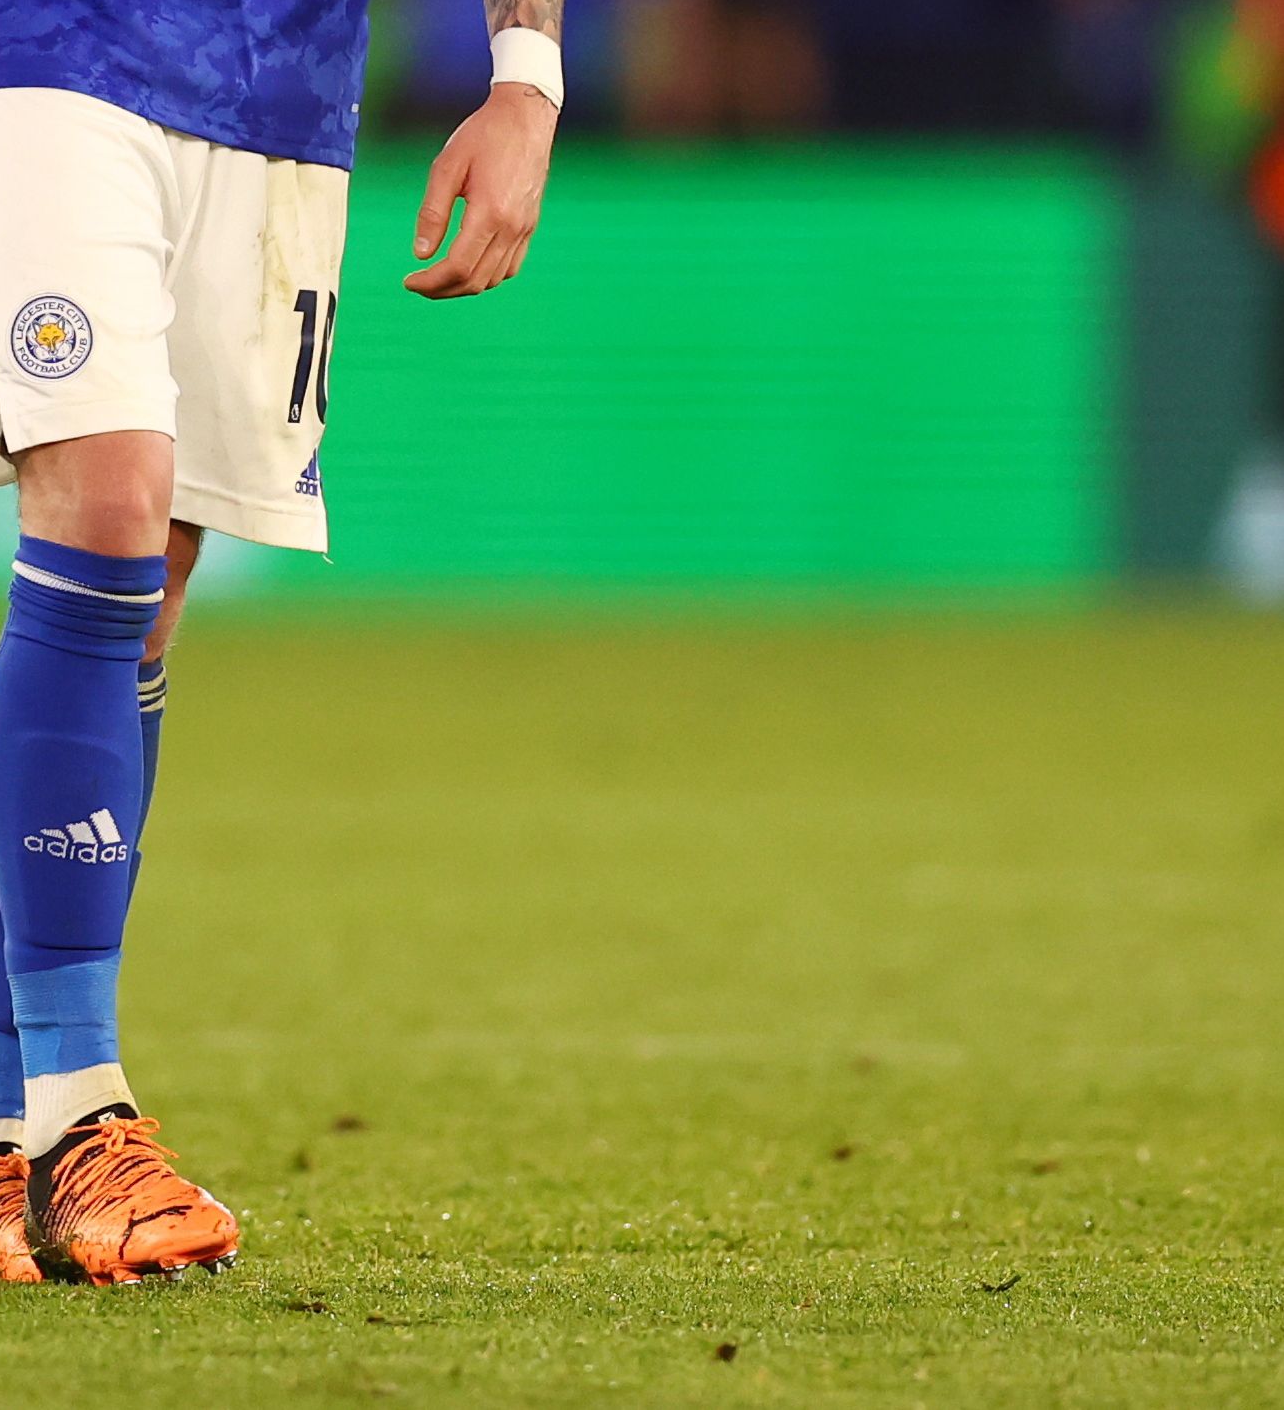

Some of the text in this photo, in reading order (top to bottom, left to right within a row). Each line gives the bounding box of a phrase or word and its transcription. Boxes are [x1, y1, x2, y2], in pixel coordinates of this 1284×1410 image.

[16, 301, 86, 340] LEICESTER CITY
[17, 337, 88, 373] FOOTBALL CLUB
[23, 834, 129, 865] adidas
